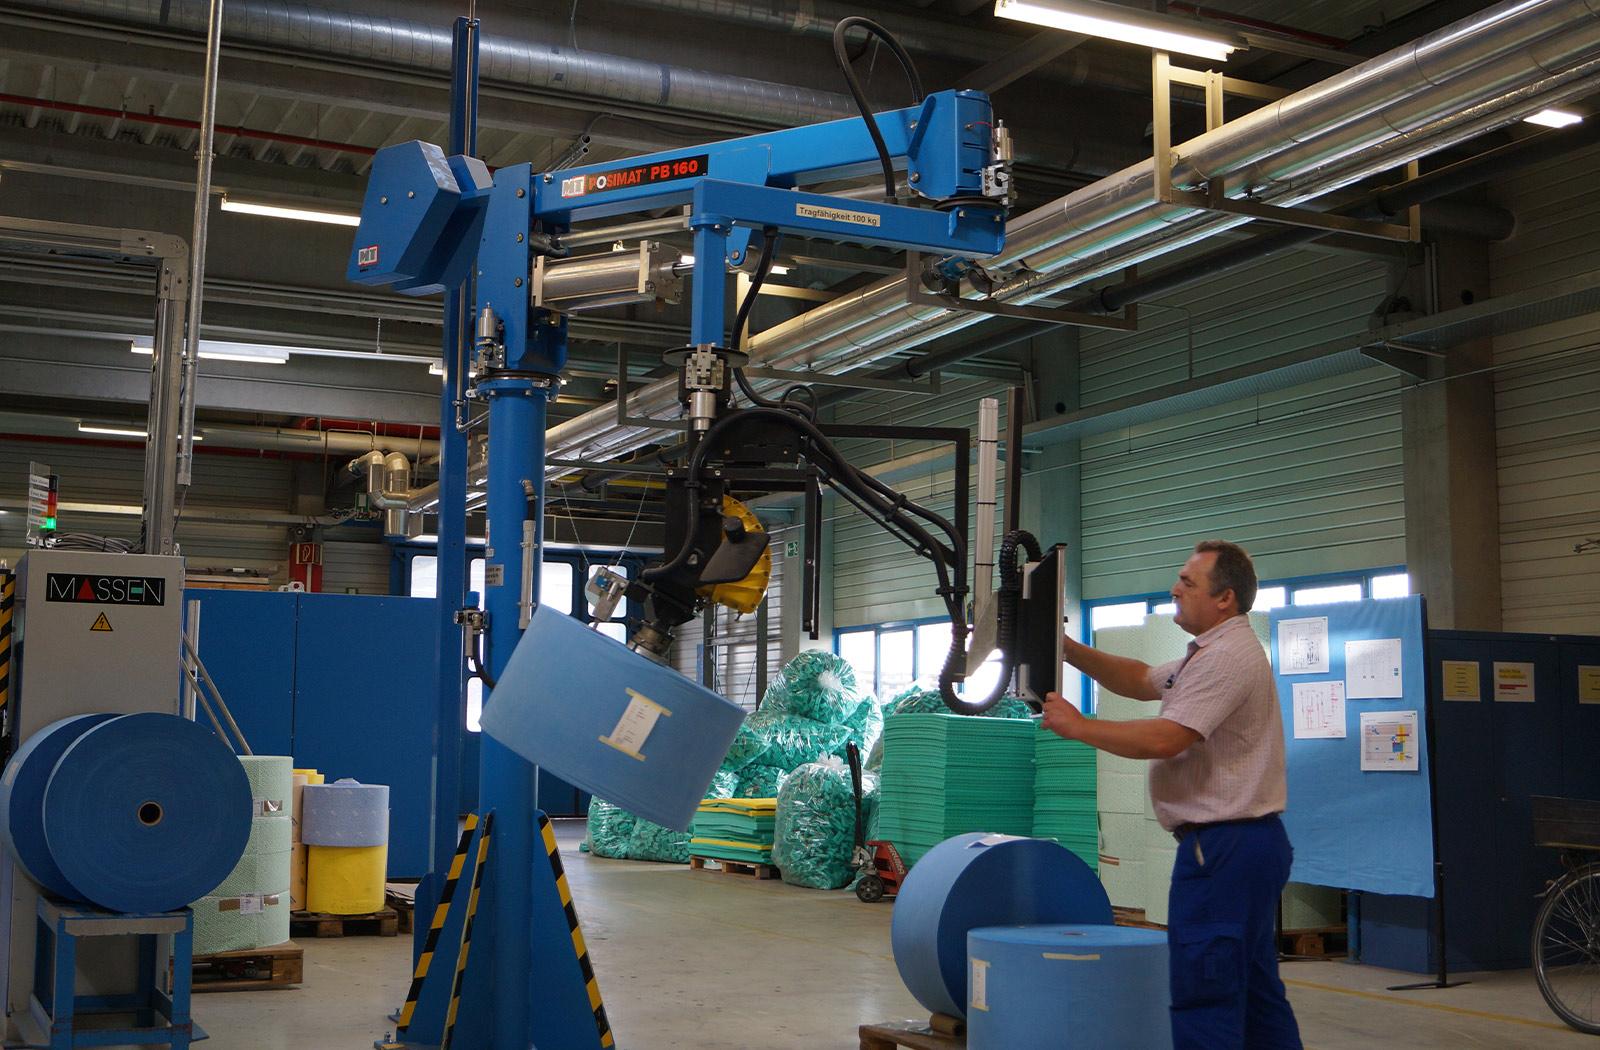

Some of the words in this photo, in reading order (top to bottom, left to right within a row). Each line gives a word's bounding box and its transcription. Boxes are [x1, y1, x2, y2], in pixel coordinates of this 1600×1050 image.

[650, 164, 670, 180] PB
[672, 160, 699, 176] 160
[799, 206, 850, 220] Tragfähigkeit
[852, 214, 866, 223] 100
[867, 216, 877, 226] kg
[50, 576, 162, 603] MASSEN
